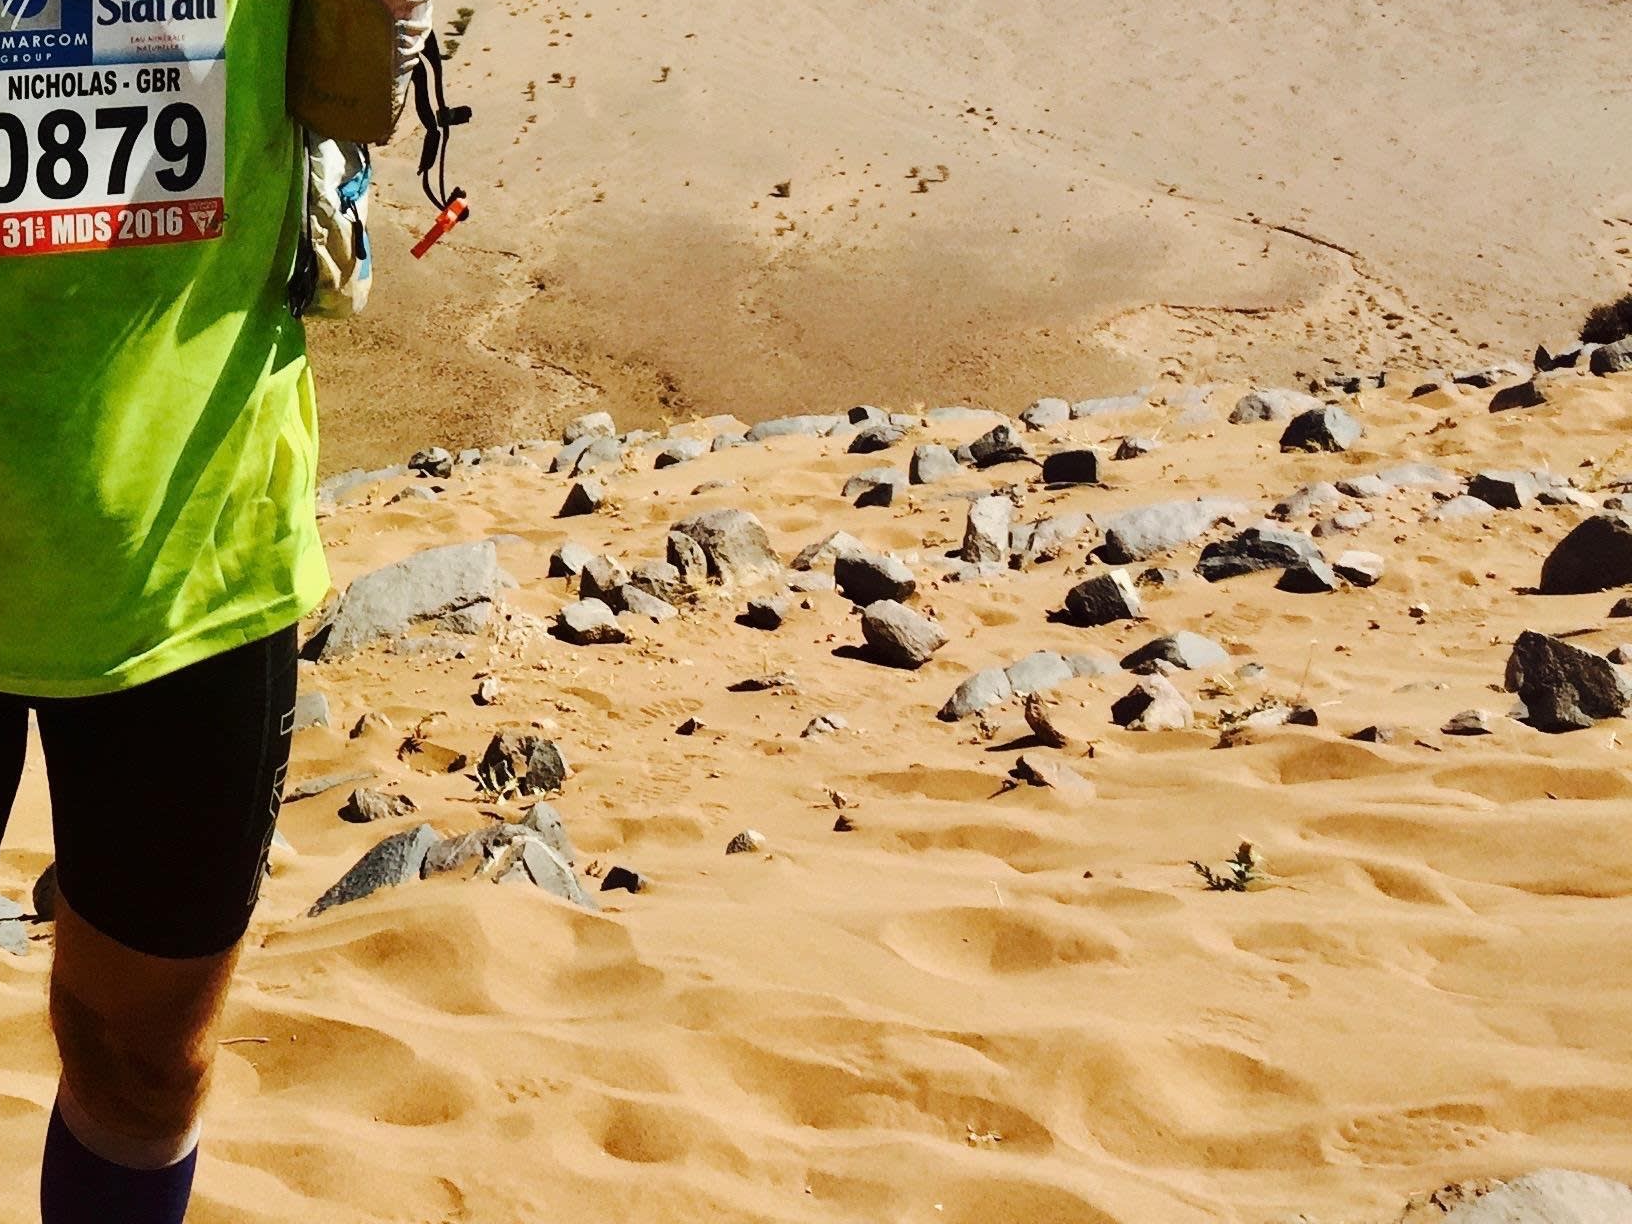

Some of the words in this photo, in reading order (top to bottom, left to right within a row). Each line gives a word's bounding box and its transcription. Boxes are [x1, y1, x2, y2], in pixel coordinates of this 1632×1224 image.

[0, 52, 52, 64] GROUP
[8, 70, 117, 101] NICHOLAS
[136, 67, 181, 94] GBR
[50, 211, 112, 246] MDS
[118, 206, 183, 239] 2016
